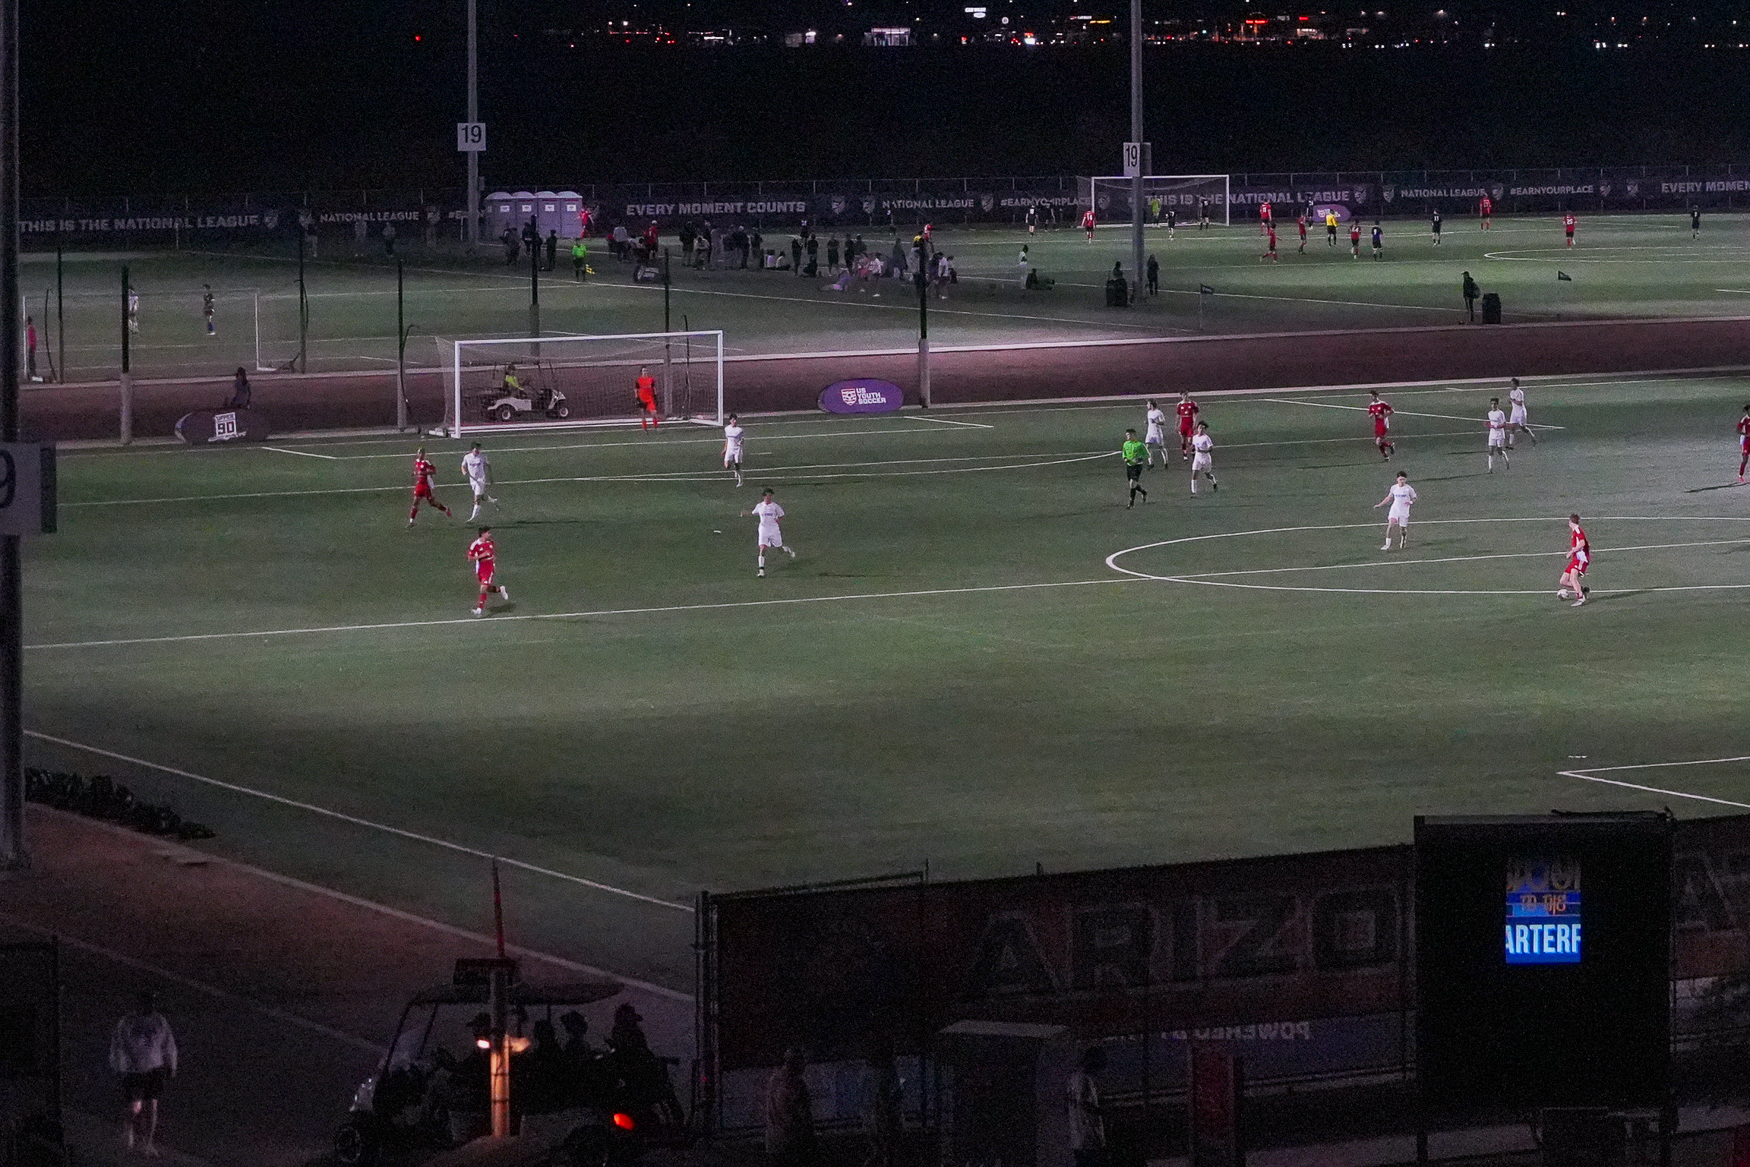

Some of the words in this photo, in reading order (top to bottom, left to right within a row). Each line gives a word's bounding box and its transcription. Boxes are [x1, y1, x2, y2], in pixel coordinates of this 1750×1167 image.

[461, 125, 483, 144] 19
[1125, 145, 1138, 168] 19
[1400, 188, 1450, 198] NATIONAL
[1661, 182, 1701, 194] EVERY
[626, 203, 676, 216] EVERY
[678, 201, 742, 215] MOMENT
[747, 200, 806, 214] COUNTS
[882, 199, 934, 210] NATIONAL
[935, 198, 975, 209] LEAGUE
[18, 219, 56, 233] THIS
[59, 219, 75, 232] IS
[77, 218, 111, 232] THE
[113, 216, 196, 231] NATIONAL
[199, 214, 261, 229] LEAGUE
[319, 211, 375, 223] NATIONAL
[377, 210, 420, 222] LEAGUE
[857, 392, 881, 400] YOUTH
[858, 397, 887, 405] SOCCER
[217, 421, 235, 436] 90
[1505, 923, 1581, 954] ARTERF
